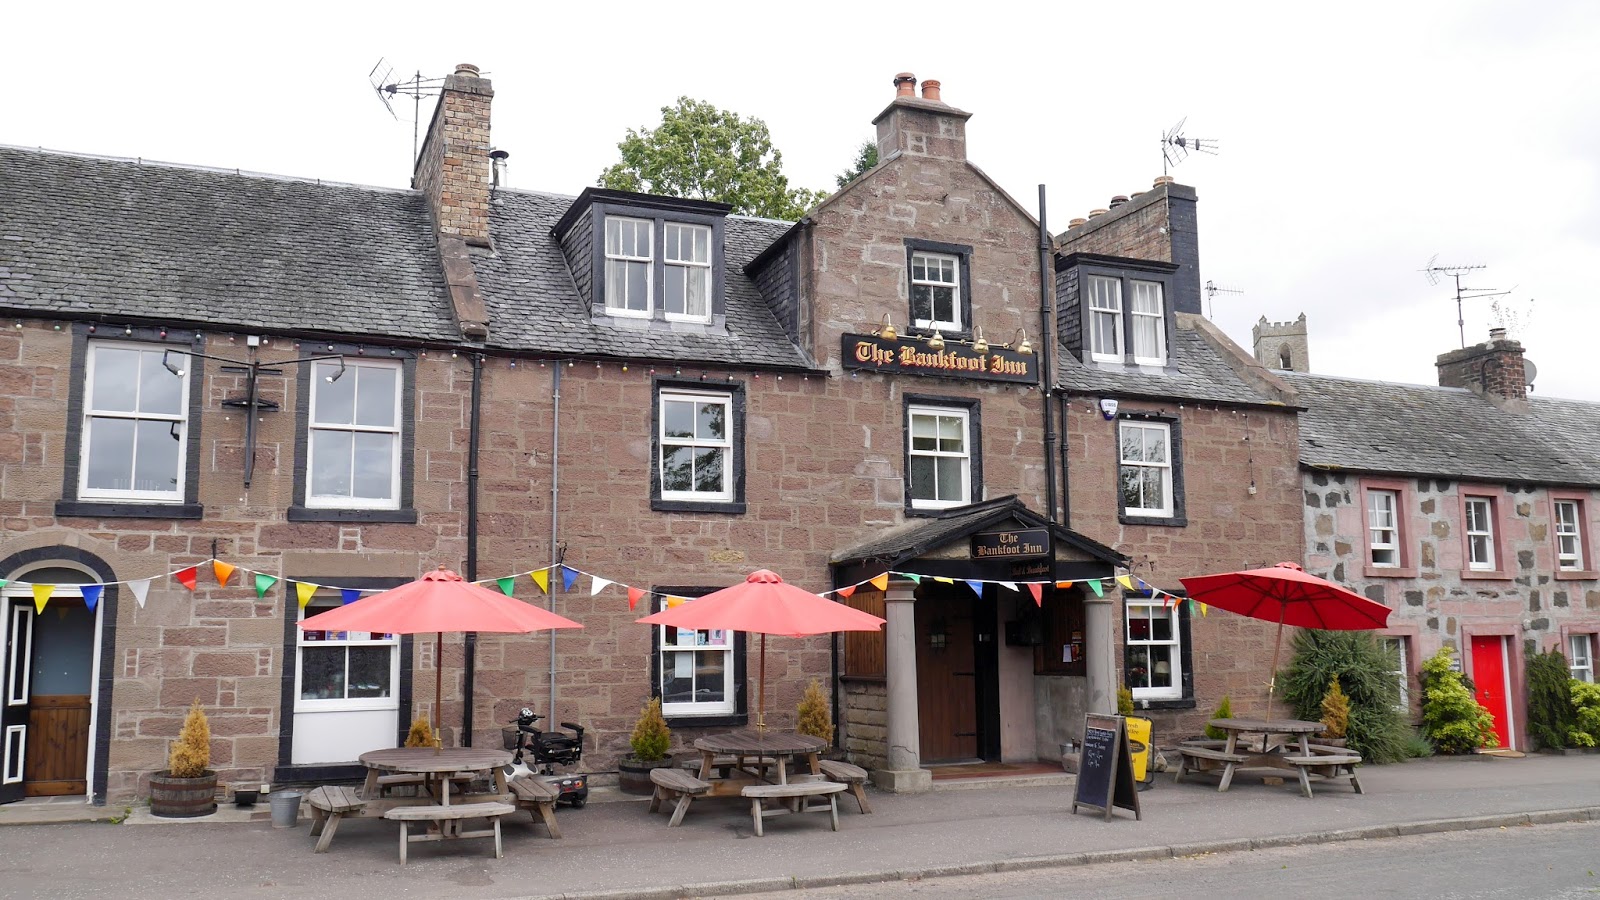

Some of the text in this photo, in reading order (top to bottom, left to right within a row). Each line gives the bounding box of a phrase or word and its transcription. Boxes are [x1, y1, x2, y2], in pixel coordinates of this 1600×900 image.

[855, 341, 1028, 376] The Bankfoot Inn
[999, 533, 1019, 544] The
[977, 542, 1043, 557] Bankfoot Inn
